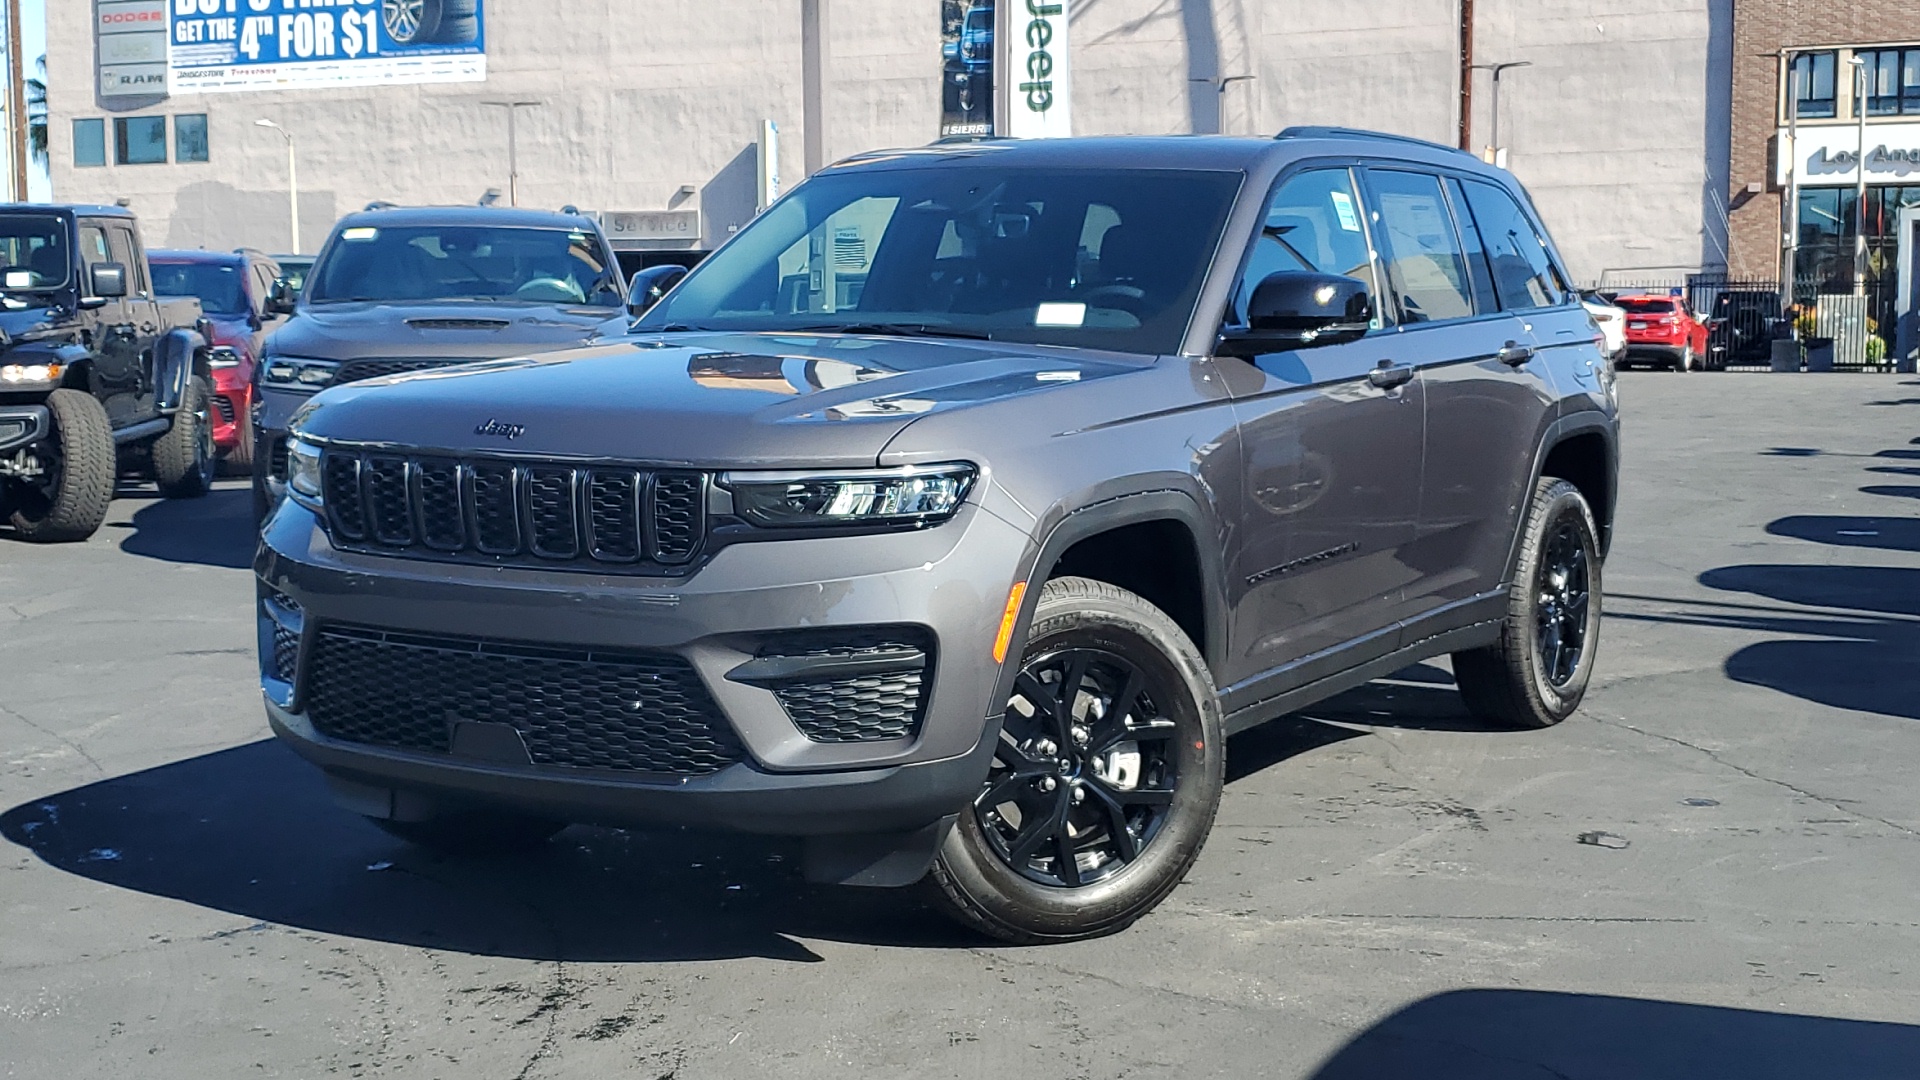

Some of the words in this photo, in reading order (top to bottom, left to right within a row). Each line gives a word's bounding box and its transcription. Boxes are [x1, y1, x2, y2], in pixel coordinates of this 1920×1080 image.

[102, 11, 163, 24] DODGE
[176, 19, 205, 43] GET
[206, 17, 237, 41] THE
[278, 11, 335, 58] FOR
[341, 7, 378, 59] $1
[1020, 0, 1062, 112] Jeep
[120, 74, 164, 84] RAM
[1820, 145, 1860, 164] Los
[613, 216, 688, 232] Service
[473, 417, 526, 440] Jeep
